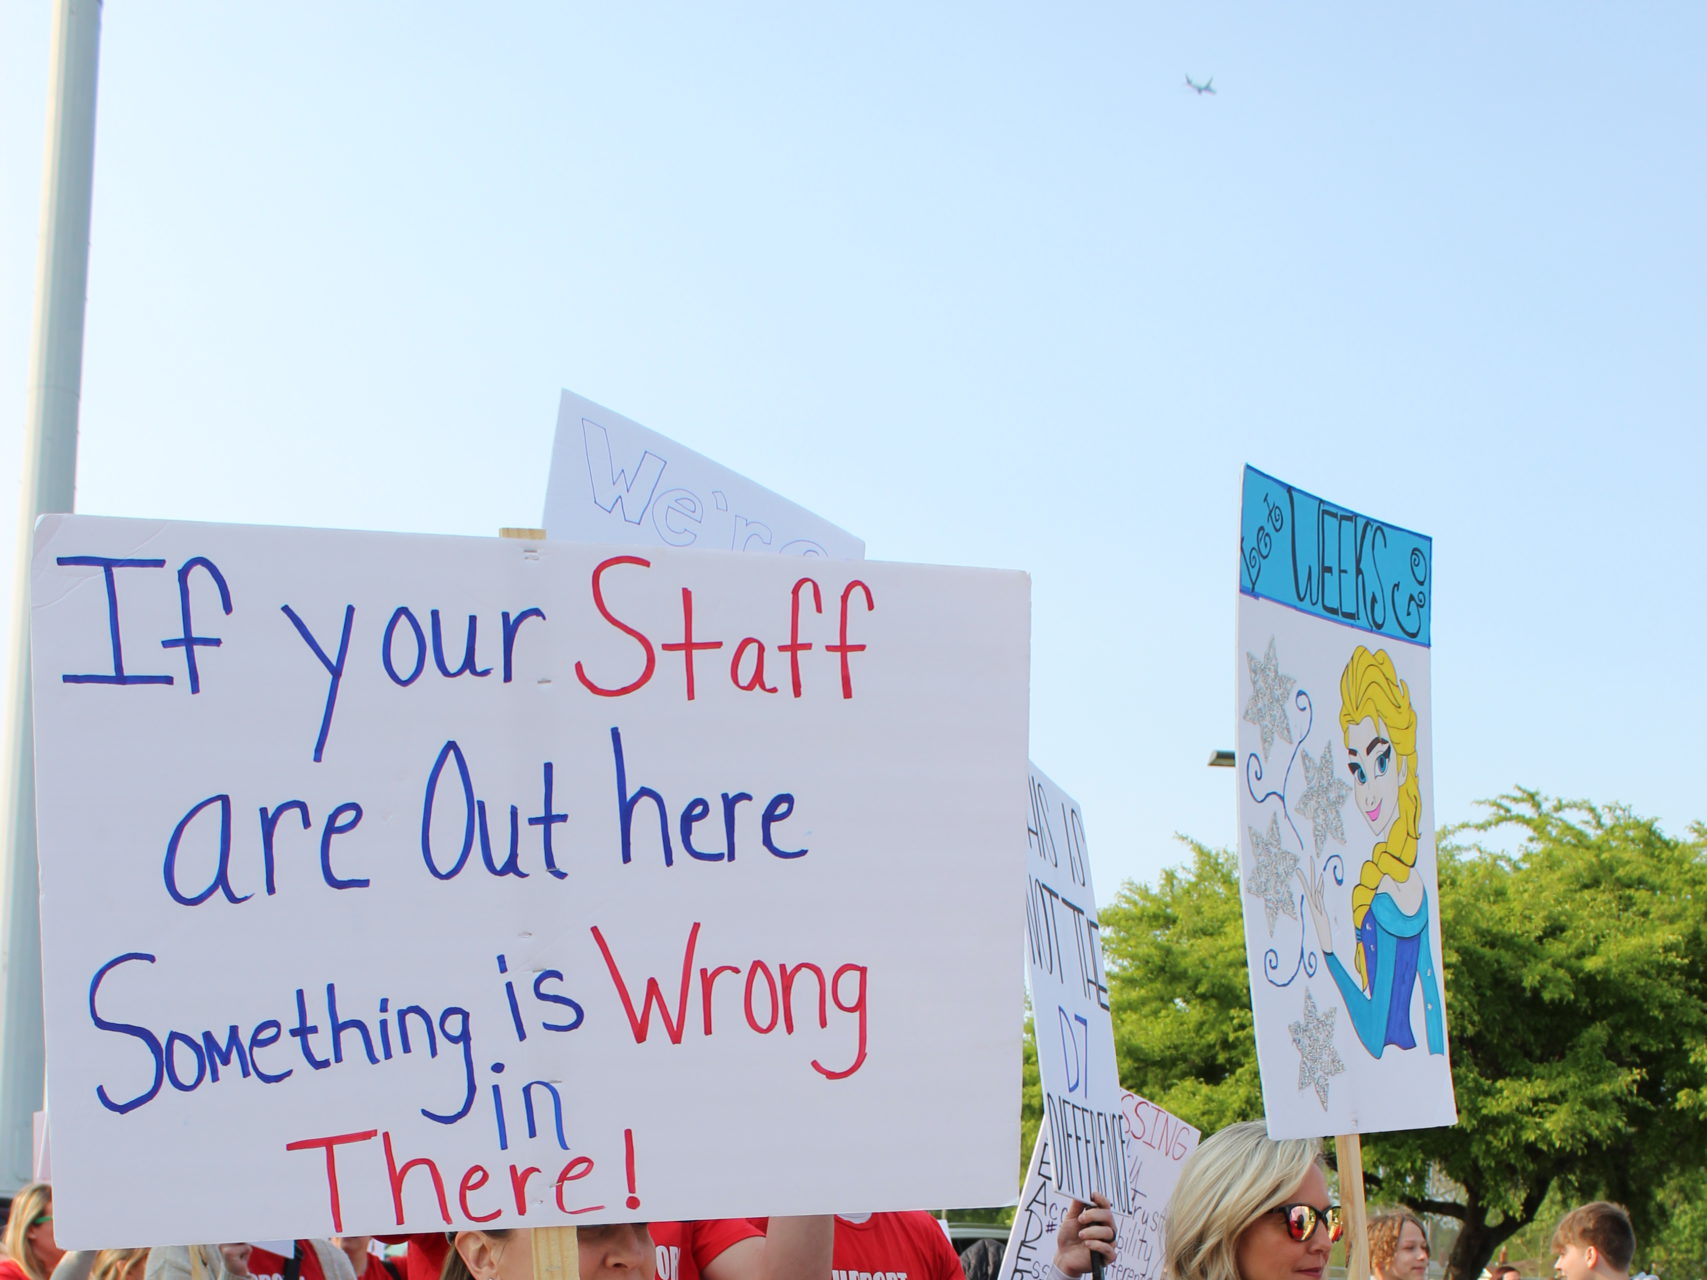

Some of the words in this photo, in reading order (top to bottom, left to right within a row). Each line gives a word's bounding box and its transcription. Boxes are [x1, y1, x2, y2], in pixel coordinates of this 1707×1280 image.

[580, 417, 829, 558] We'r
[1286, 486, 1388, 632] WEEKS
[56, 555, 233, 695] If
[280, 603, 547, 763] your
[574, 554, 876, 701] Staff
[162, 793, 371, 906] are
[420, 740, 586, 880] Out
[610, 726, 810, 868] here
[89, 952, 478, 1125] Something
[496, 953, 585, 1042] is
[591, 922, 869, 1080] Wrong
[1058, 1004, 1089, 1099] D7
[490, 1062, 570, 1151] in
[286, 1128, 642, 1233] There!
